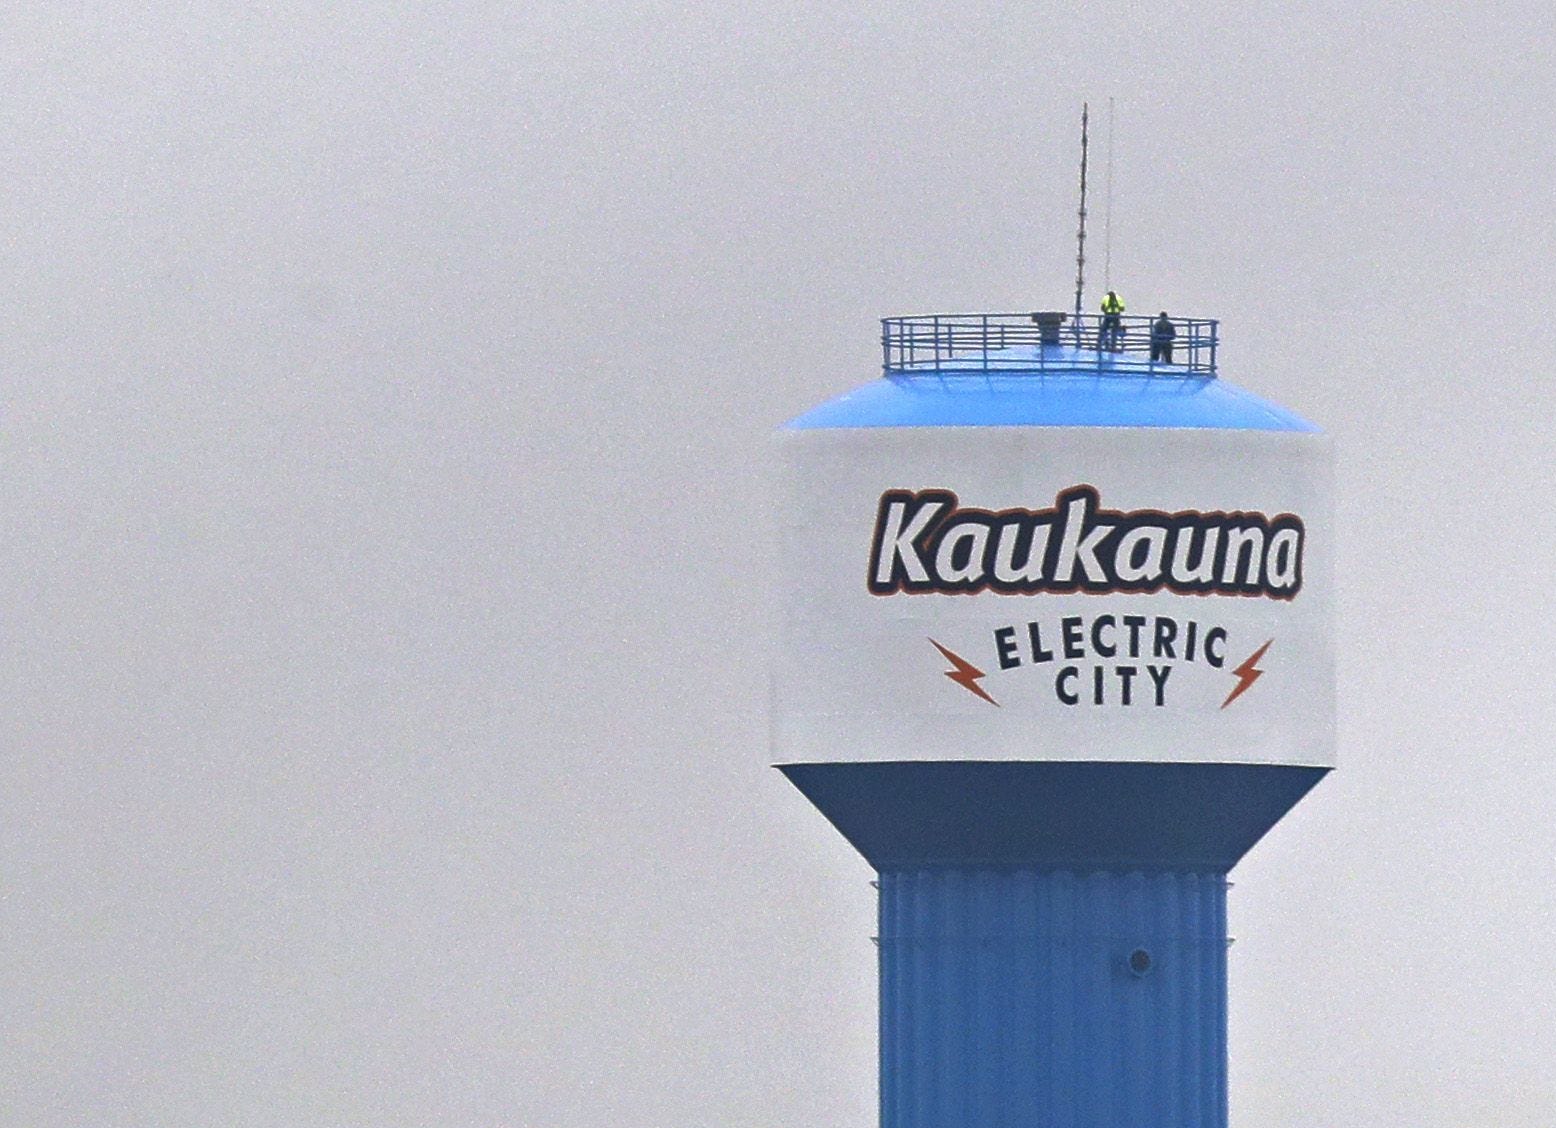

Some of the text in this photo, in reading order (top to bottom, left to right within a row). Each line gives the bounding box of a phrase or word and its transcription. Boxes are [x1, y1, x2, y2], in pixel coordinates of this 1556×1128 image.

[869, 485, 1304, 601] Kaukauna
[995, 614, 1227, 670] ELECTRIC
[1055, 665, 1172, 706] CITY
